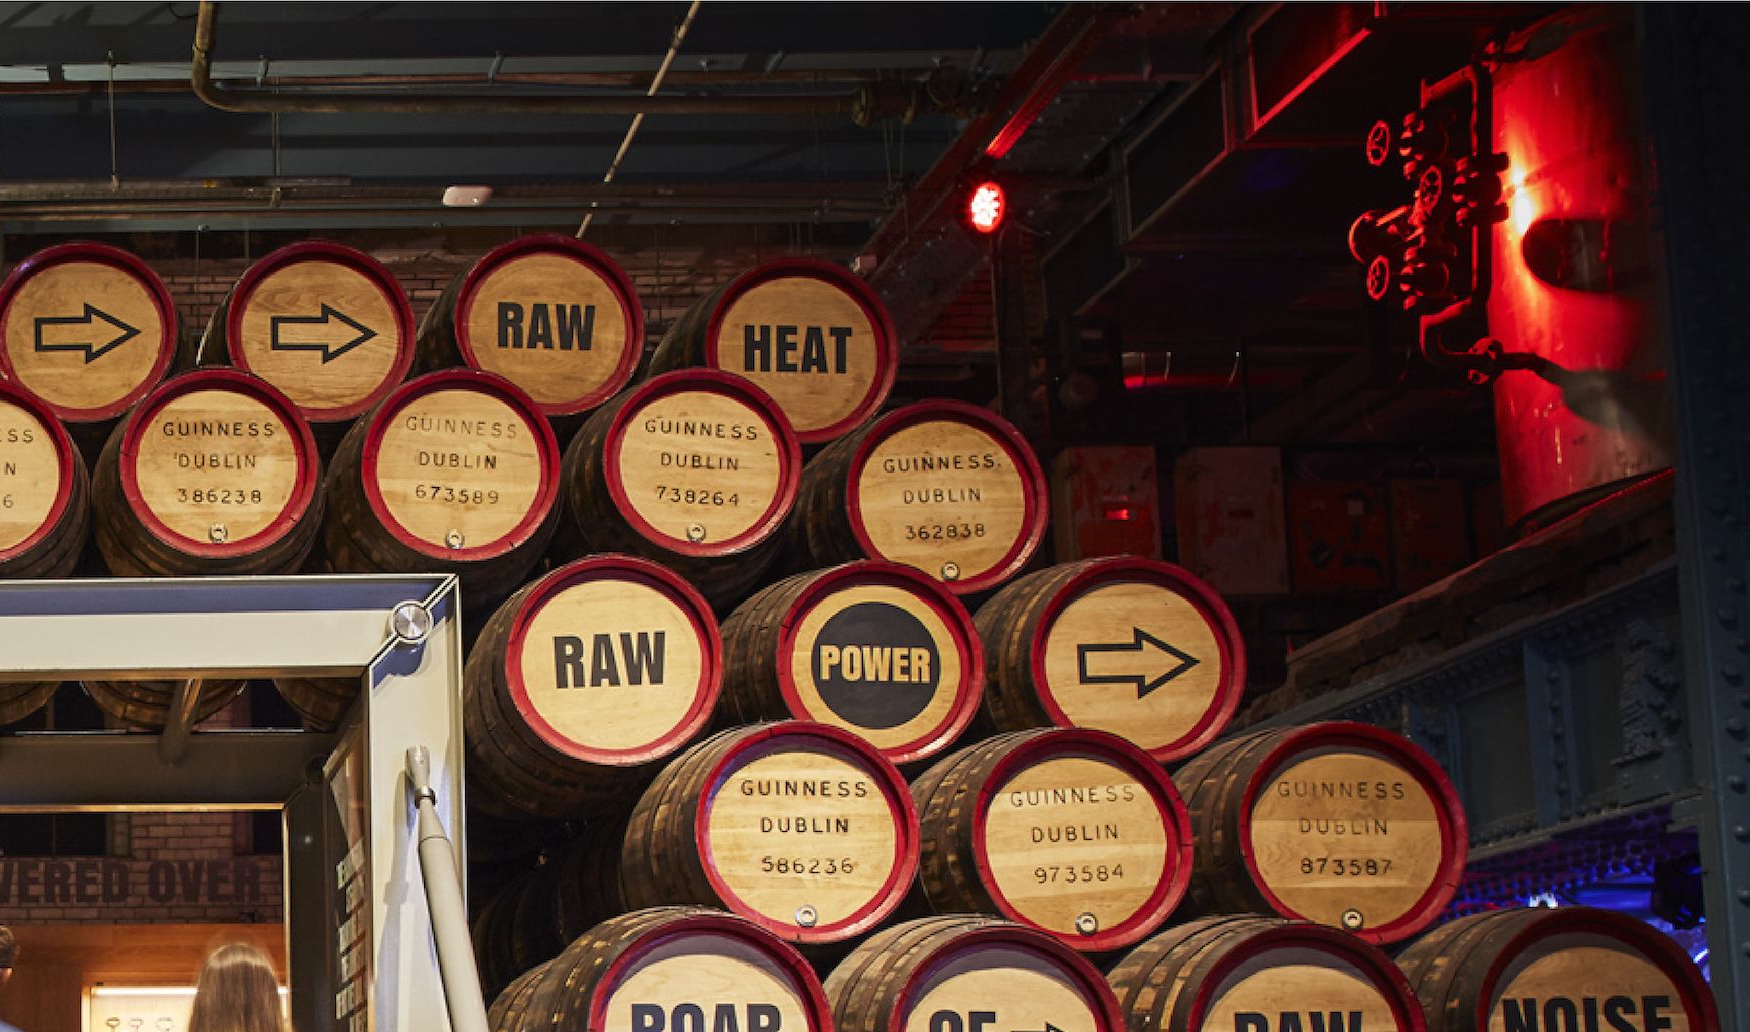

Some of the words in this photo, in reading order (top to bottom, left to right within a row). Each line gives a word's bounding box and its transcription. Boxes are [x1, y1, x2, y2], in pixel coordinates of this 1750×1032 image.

[497, 301, 596, 352] RAW
[744, 324, 852, 374] HEAT
[163, 421, 274, 437] GUINNESS
[406, 416, 517, 439] GUINNESS
[644, 418, 759, 442] GUINNESS
[178, 453, 256, 469] DUBLIN
[419, 451, 497, 469] DUBLIN
[660, 451, 739, 472] DUBLIN
[883, 454, 995, 473] GUINNESS
[177, 488, 261, 505] 386238
[416, 484, 499, 505] 673589
[656, 486, 740, 507] 738264
[903, 488, 981, 504] DUBLIN
[905, 522, 986, 541] 362838
[553, 630, 666, 689] RAW
[820, 645, 932, 684] POWER
[741, 780, 868, 797] GUINNESS
[1009, 785, 1136, 808] GUINNESS
[1277, 779, 1405, 800] GUINNESS
[761, 817, 848, 833] DUBLIN
[1031, 822, 1119, 843] DUBLIN
[1299, 816, 1389, 836] DUBLIN
[761, 856, 854, 874] 586236
[1034, 862, 1124, 884] 973584
[1300, 858, 1393, 877] 873587
[149, 859, 262, 904] OVER
